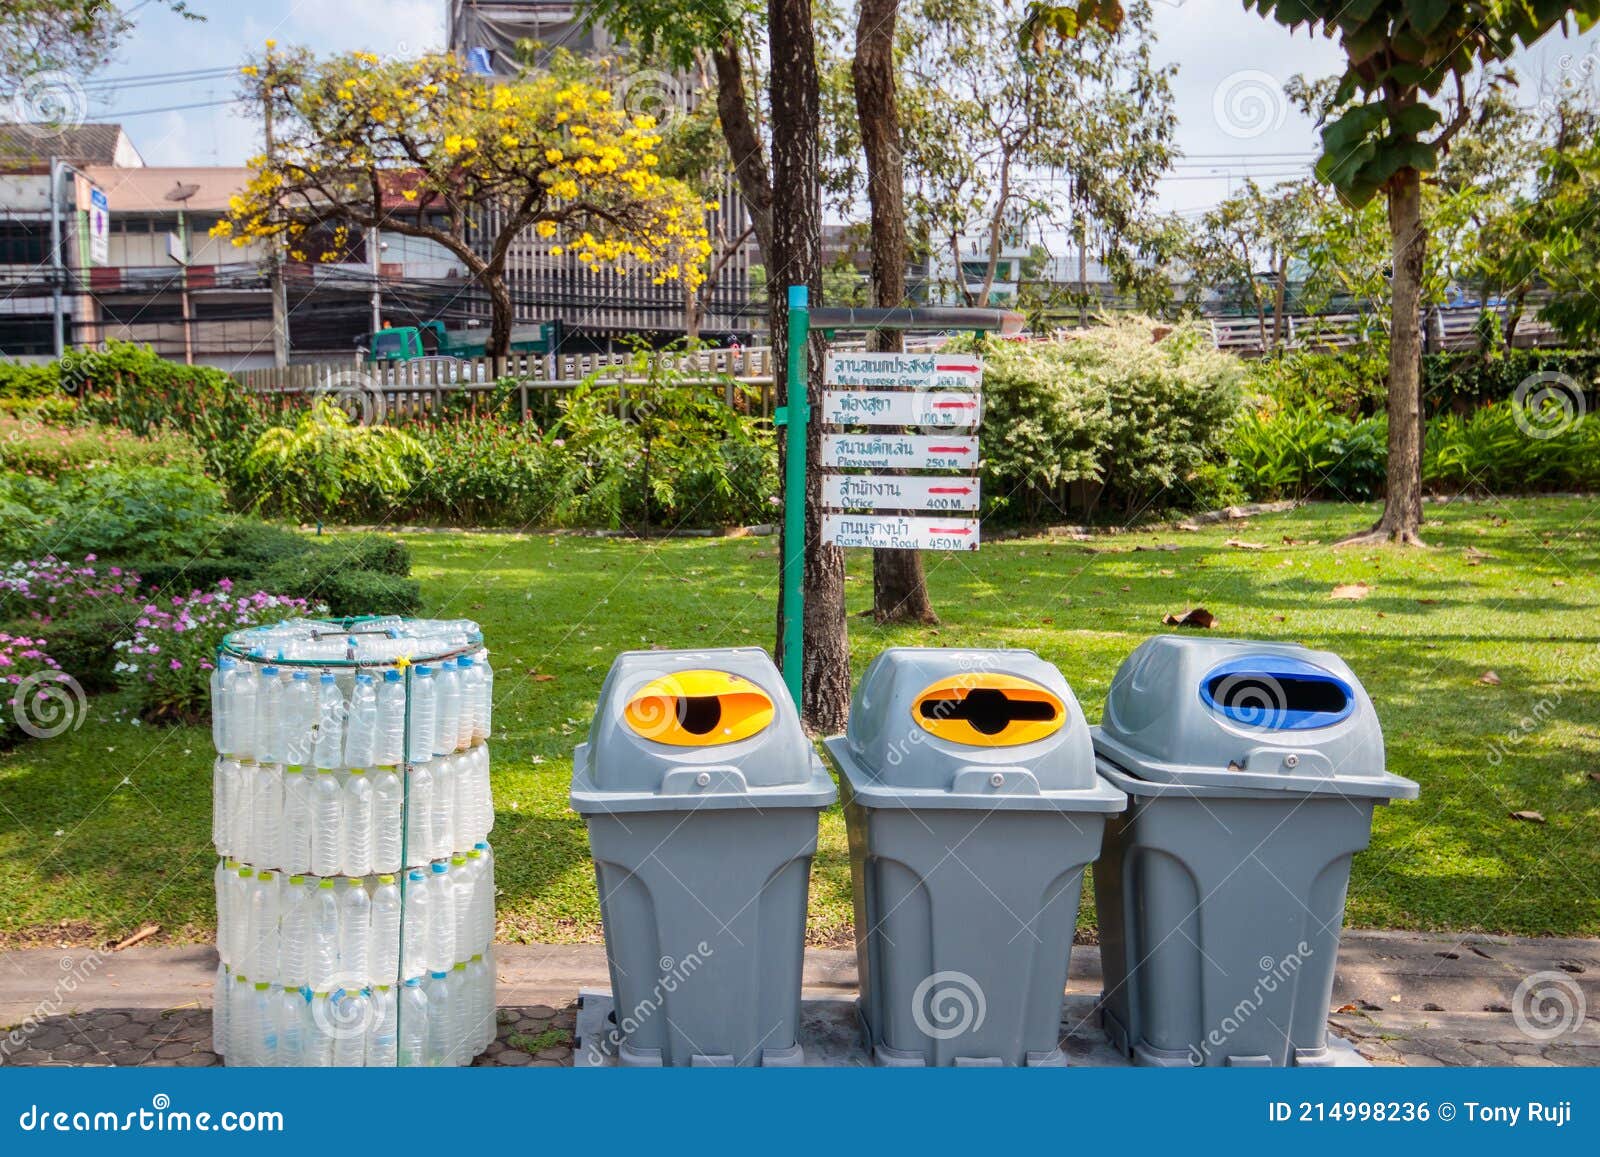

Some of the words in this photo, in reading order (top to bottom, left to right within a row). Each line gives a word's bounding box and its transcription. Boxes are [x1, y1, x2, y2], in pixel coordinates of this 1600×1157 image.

[840, 393, 891, 416] ห้องสุขา
[919, 413, 938, 425] 100
[926, 458, 945, 468] 250
[840, 476, 901, 497] สำนักงาน
[841, 497, 874, 508] Office
[926, 498, 948, 509] 400
[840, 518, 909, 536] ถนนรางน้ำ
[865, 535, 887, 547] Nam
[891, 537, 919, 548] Road
